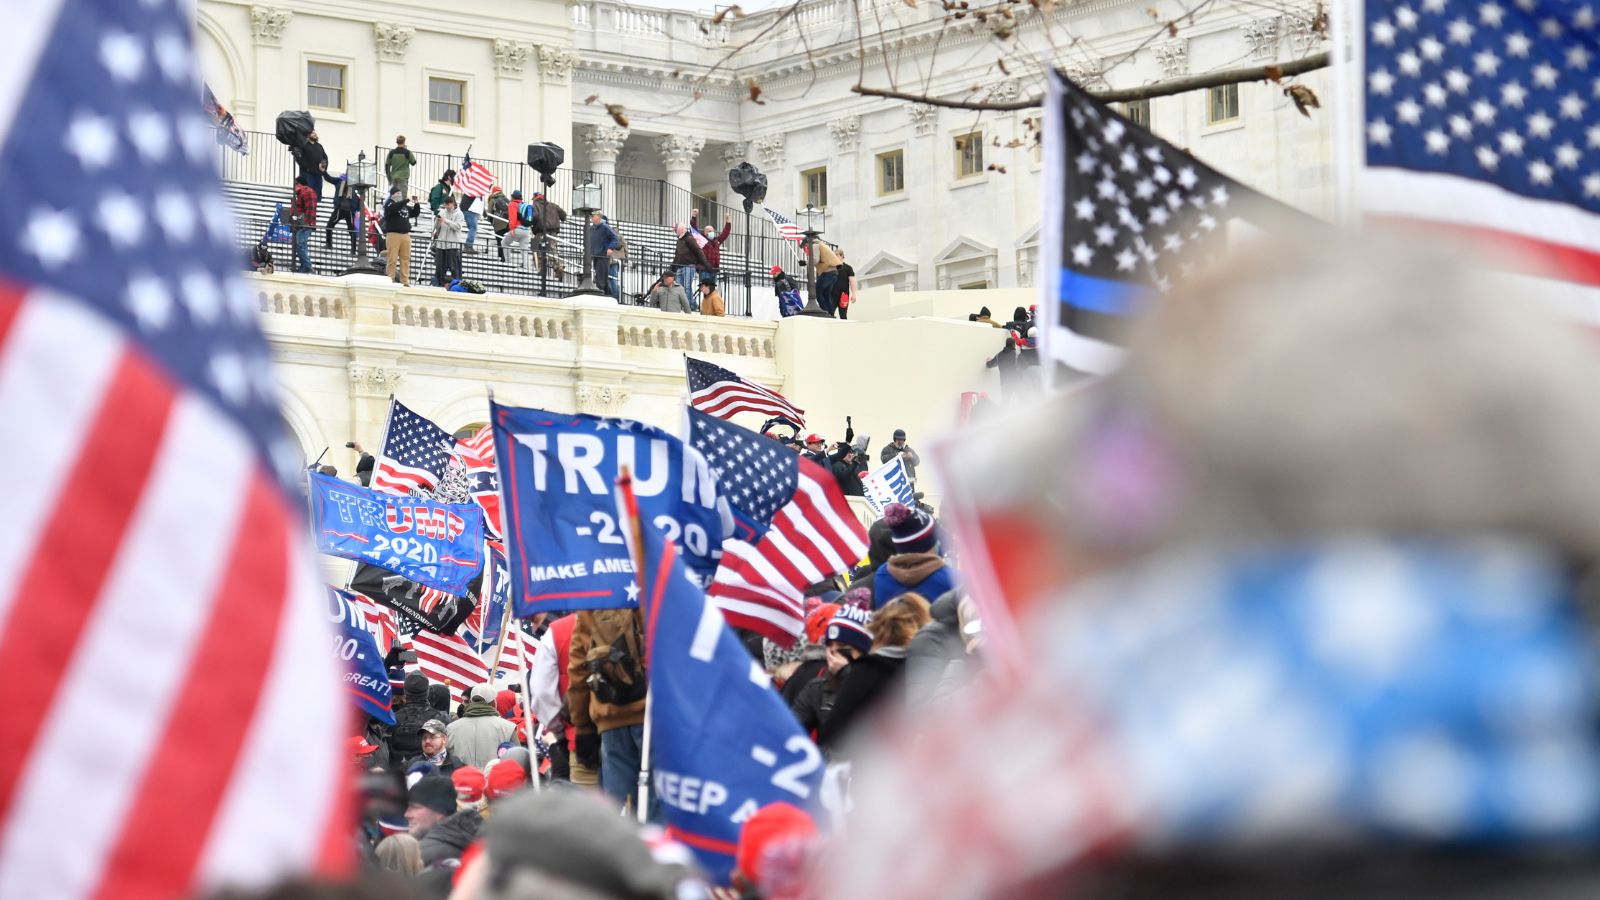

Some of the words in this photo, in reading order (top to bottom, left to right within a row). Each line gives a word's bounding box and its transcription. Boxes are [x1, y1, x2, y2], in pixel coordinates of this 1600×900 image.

[513, 432, 736, 541] TRUM
[329, 490, 465, 543] TRUMP
[373, 534, 437, 564] 2020
[530, 563, 588, 582] MAKE
[342, 671, 392, 696] GREAT!
